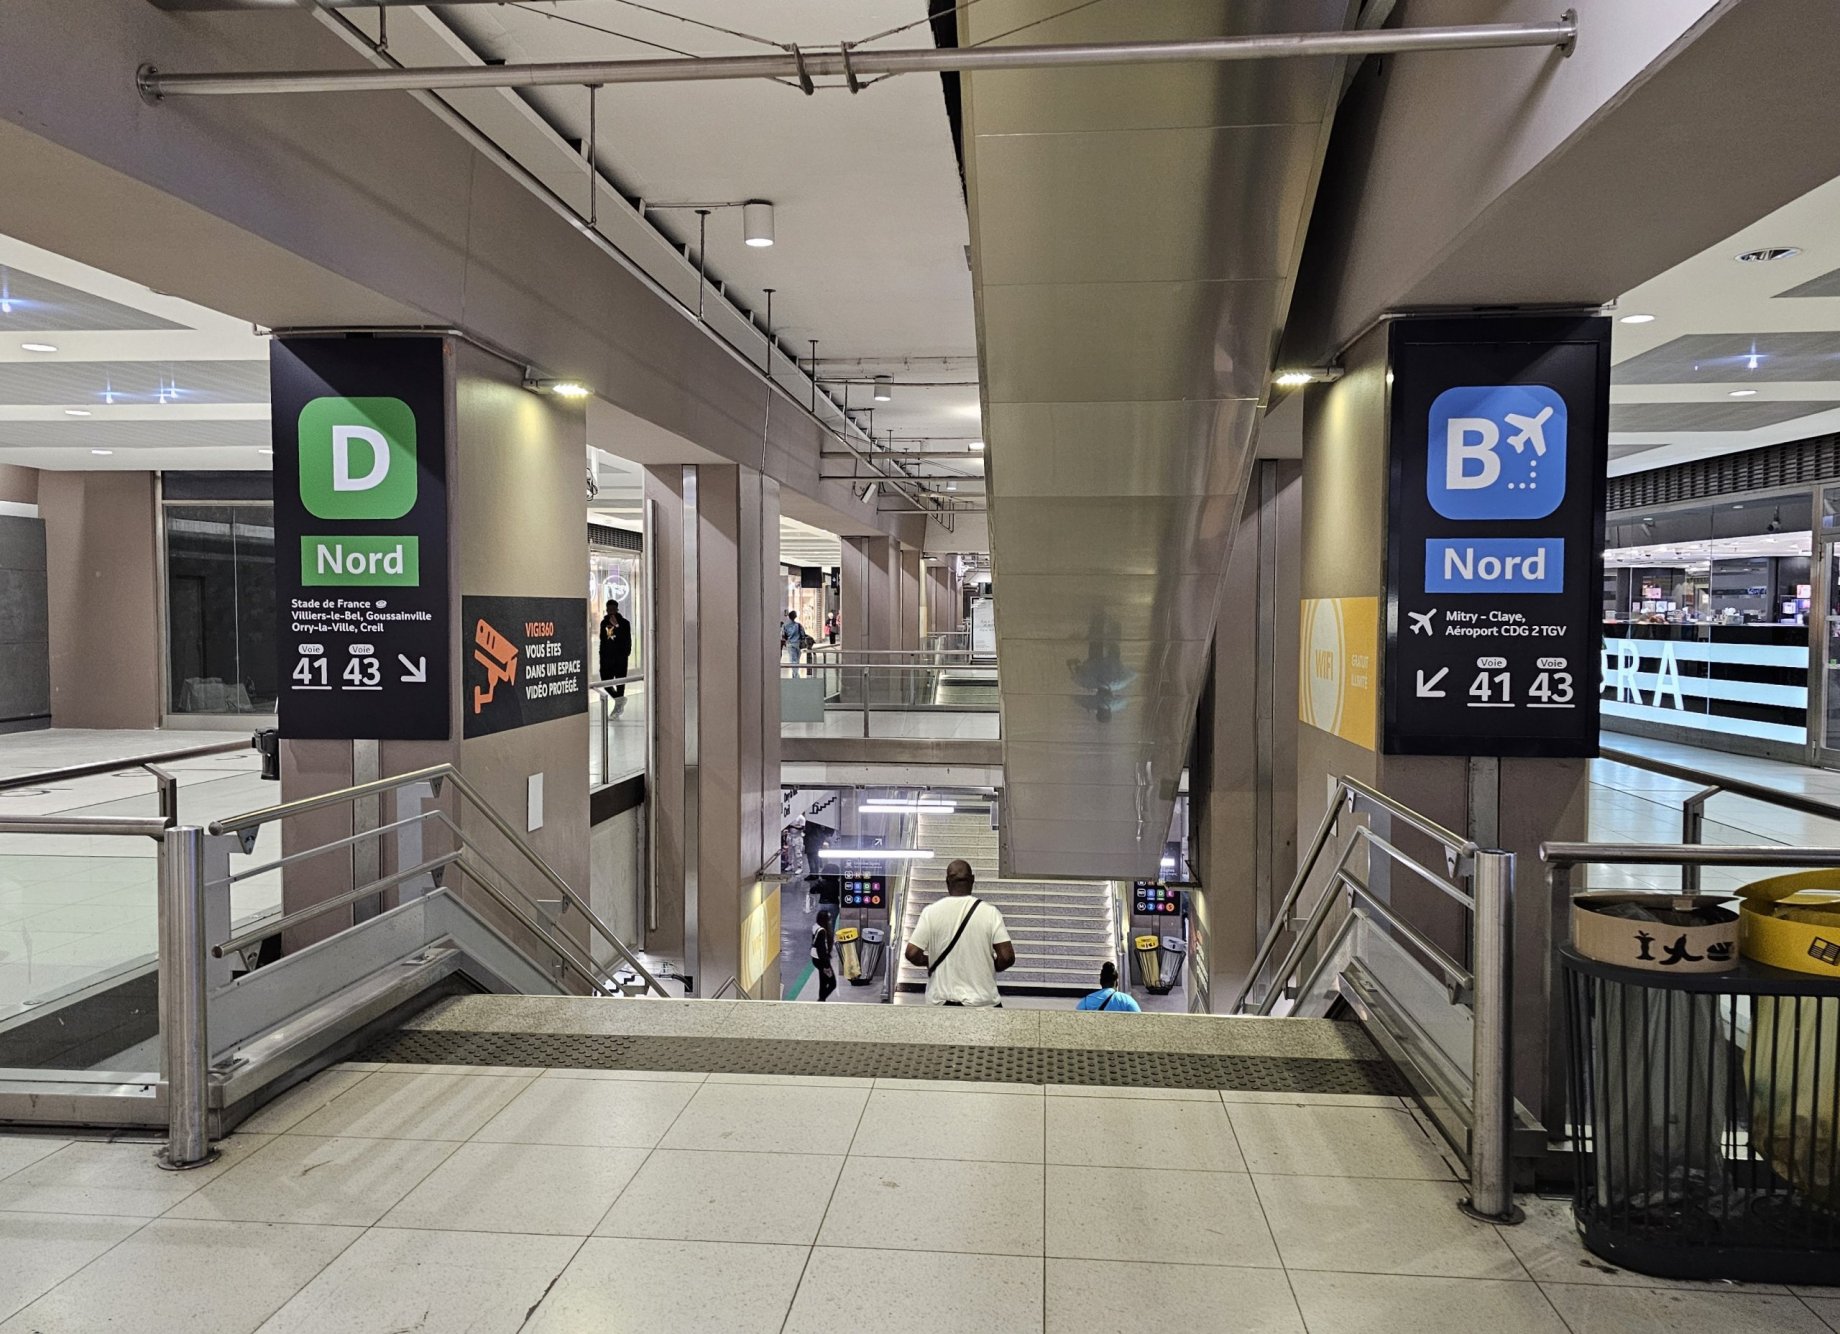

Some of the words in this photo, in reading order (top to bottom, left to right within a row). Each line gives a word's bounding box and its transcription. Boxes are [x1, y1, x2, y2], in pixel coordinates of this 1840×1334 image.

[332, 425, 390, 491] D
[1446, 418, 1501, 490] B
[317, 544, 403, 574] Nord
[1444, 547, 1546, 580] Nord
[291, 598, 321, 609] Stade
[322, 598, 335, 609] de
[337, 599, 371, 609] France
[291, 611, 364, 622] Villiers-le-Bel,
[366, 611, 432, 621] Goussainville
[1446, 611, 1478, 624] Mitry
[1489, 610, 1526, 624] Claye,
[291, 622, 358, 634] Orry-la-Ville,
[360, 622, 384, 632] Creil
[525, 622, 554, 637] VIGI360
[1445, 625, 1499, 638] Aéroport
[1501, 625, 1529, 636] CDG
[1531, 625, 1540, 636] 2
[1541, 625, 1567, 636] TGV
[352, 646, 371, 654] Voie
[525, 643, 545, 659] VOUS
[546, 640, 562, 657] ÊTES
[292, 657, 328, 685] 41
[342, 657, 381, 686] 43
[525, 663, 546, 680] DANS
[546, 663, 557, 677] UN
[557, 660, 581, 675] ESPACE
[1315, 648, 1334, 681] WIFI
[1481, 659, 1503, 667] Voie
[1540, 659, 1563, 667] Voie
[525, 681, 548, 700] VIDÉO
[548, 676, 579, 696] PROTÉGÉ.
[1469, 671, 1511, 702] 41
[1528, 672, 1574, 703] 43
